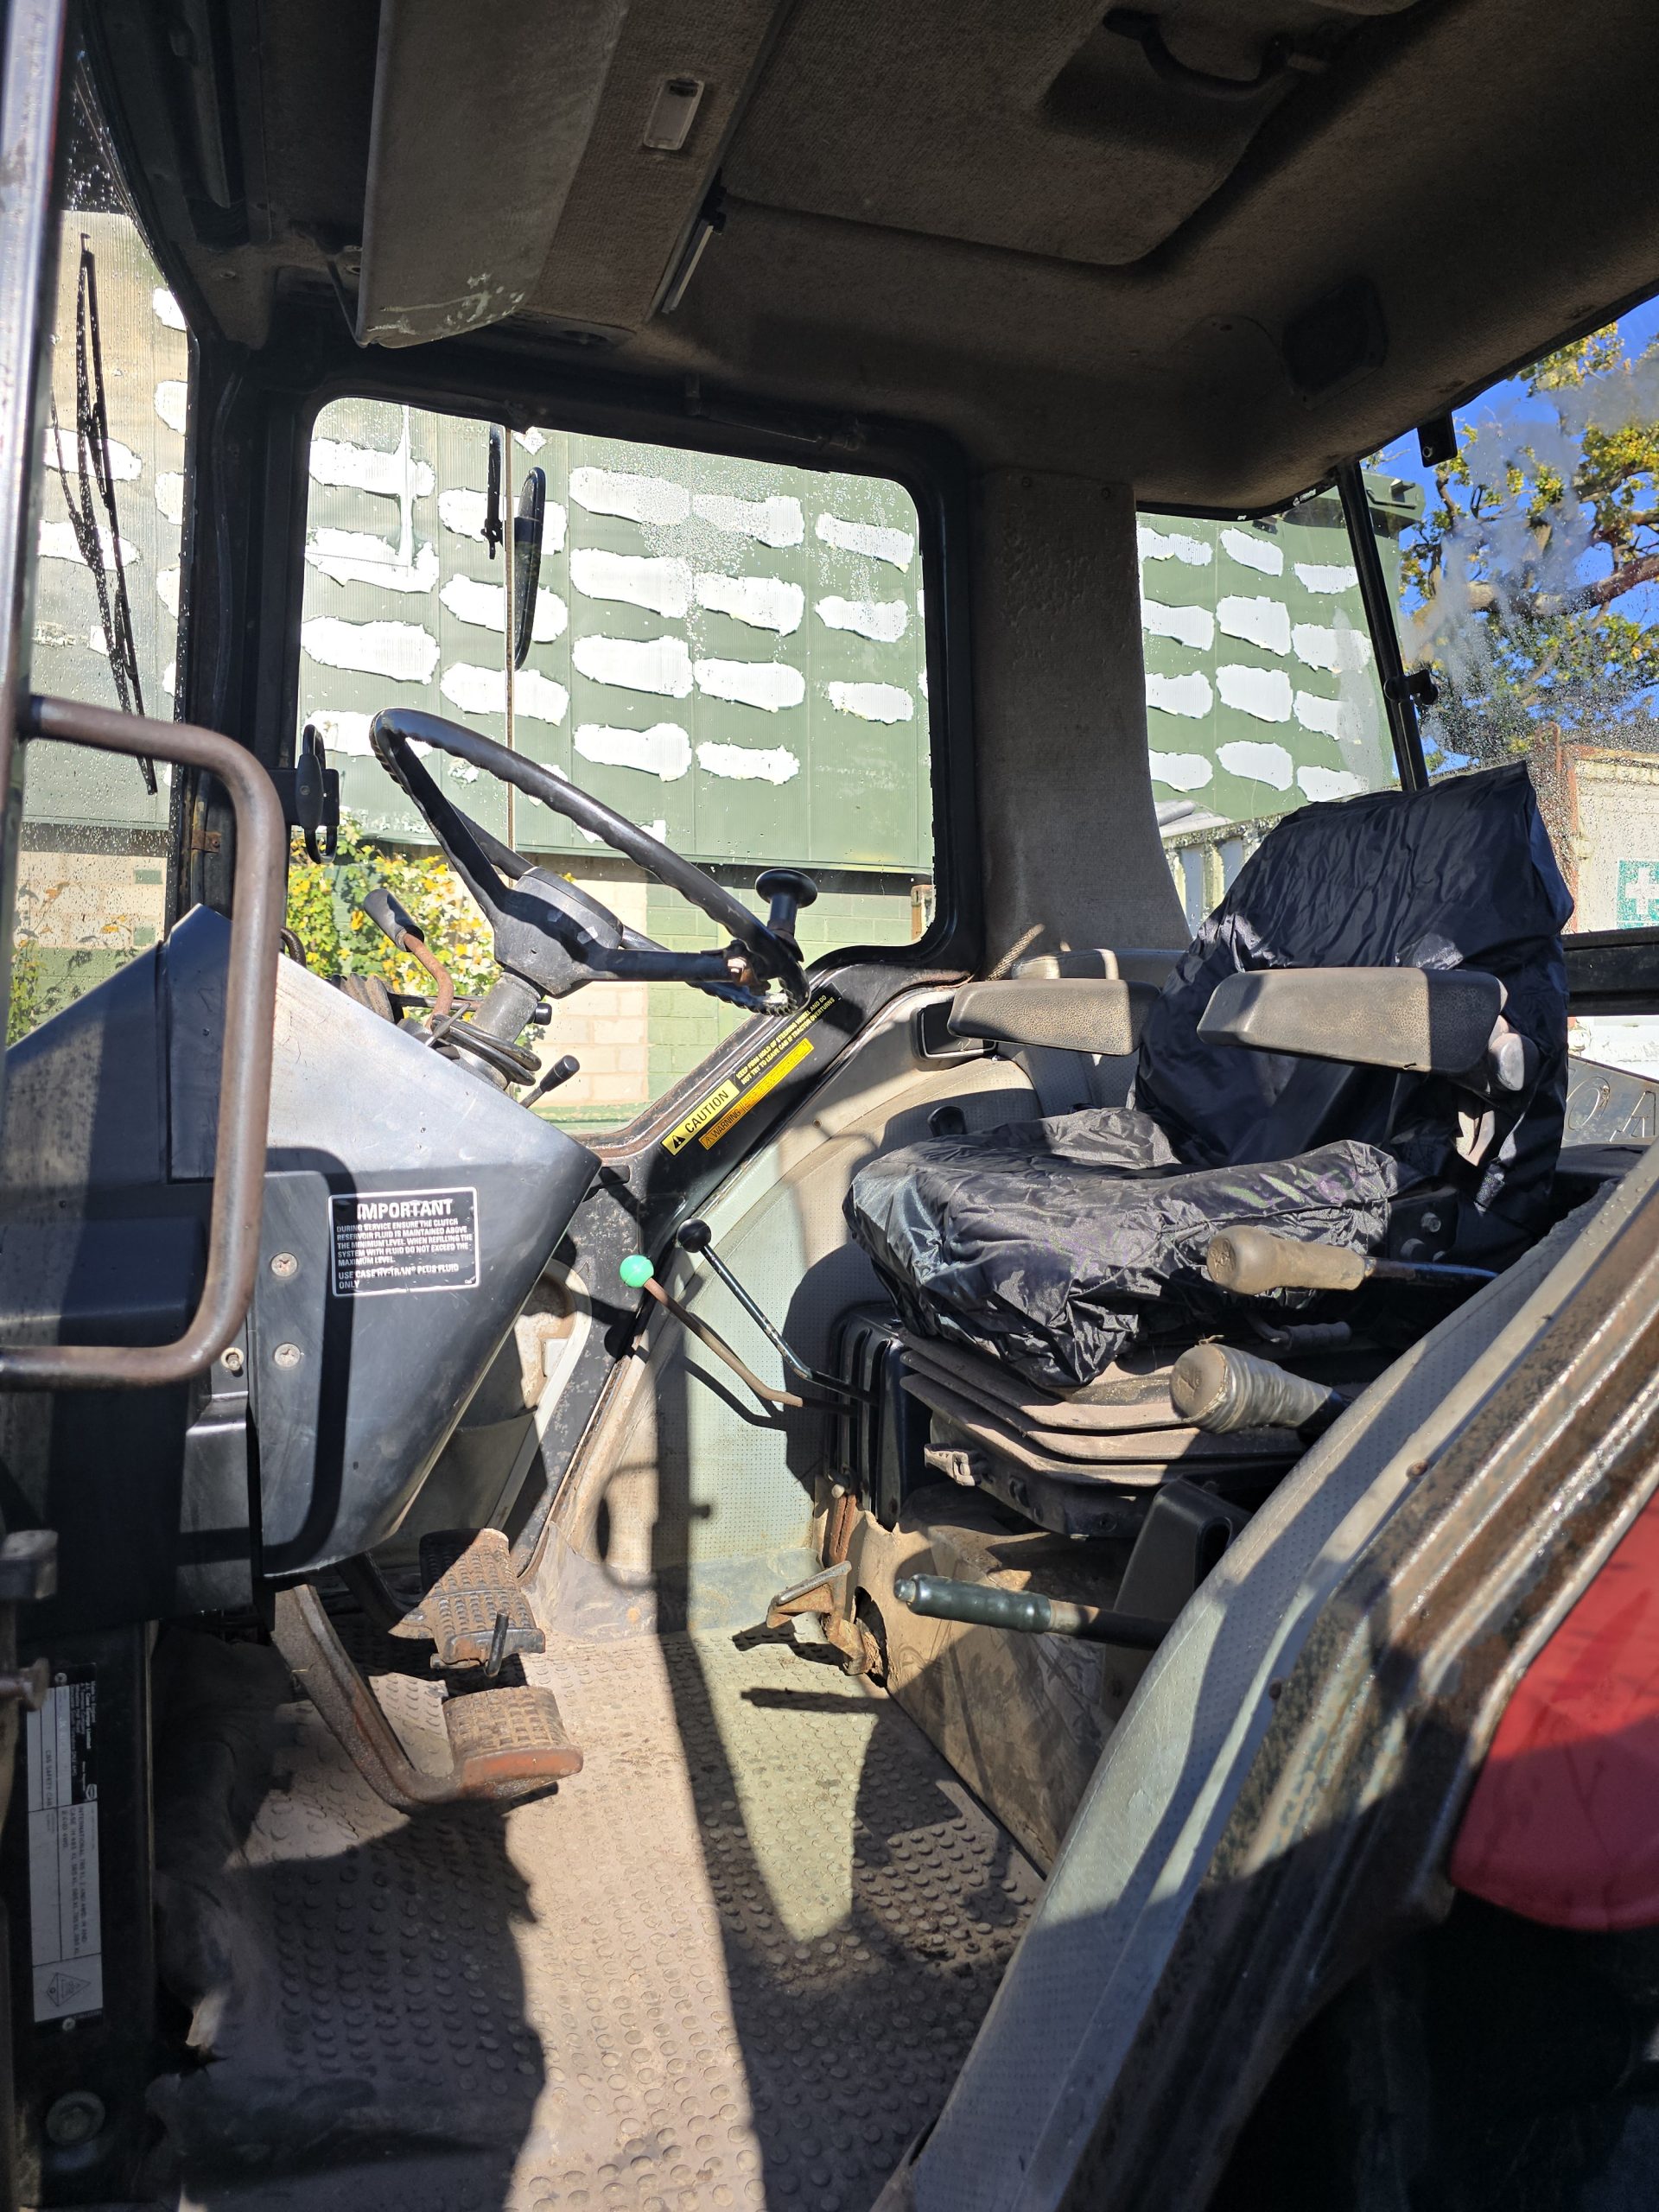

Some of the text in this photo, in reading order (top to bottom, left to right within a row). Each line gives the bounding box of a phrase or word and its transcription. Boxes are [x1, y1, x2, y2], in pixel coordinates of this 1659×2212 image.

[735, 1065, 749, 1079] KEEP
[758, 1045, 771, 1059] HOLD
[769, 1039, 777, 1048] OF
[775, 1021, 797, 1043] STEERING
[795, 1009, 810, 1024] WHEEL
[809, 1000, 820, 1011] AND
[818, 994, 826, 1003] DO
[740, 1072, 752, 1085] NOT
[750, 1064, 760, 1076] TRY
[759, 1058, 767, 1068] TO
[765, 1046, 780, 1062] LEAVE
[777, 1039, 789, 1050] CAB
[791, 1018, 812, 1038] TRACTOR
[809, 996, 835, 1021] OVERTURNS
[685, 1090, 729, 1133] CAUTION
[712, 1109, 741, 1137] WARNING
[357, 1198, 453, 1220] IMPORTANT
[337, 1224, 362, 1233] DURING
[364, 1223, 391, 1231] SERVICE
[392, 1220, 419, 1229] ENSURE
[433, 1218, 458, 1227] CLUTCH
[337, 1232, 374, 1241] RESERVOIR
[375, 1230, 393, 1239] FLUID
[403, 1227, 445, 1237] MAINTAINED
[446, 1226, 467, 1234] ABOVE
[352, 1239, 385, 1249] MINIMUM
[407, 1236, 427, 1245] WHEN
[429, 1234, 460, 1243] REFILLING
[338, 1242, 469, 1258] SYSTEM WITH FLUID DO NOT EXCEED THE
[338, 1257, 373, 1266] MAXIMUM
[339, 1271, 354, 1280] USE
[356, 1269, 375, 1278] CASE
[417, 1265, 436, 1274] PLUS
[437, 1263, 459, 1273] FLUID
[339, 1281, 360, 1289] ONLY
